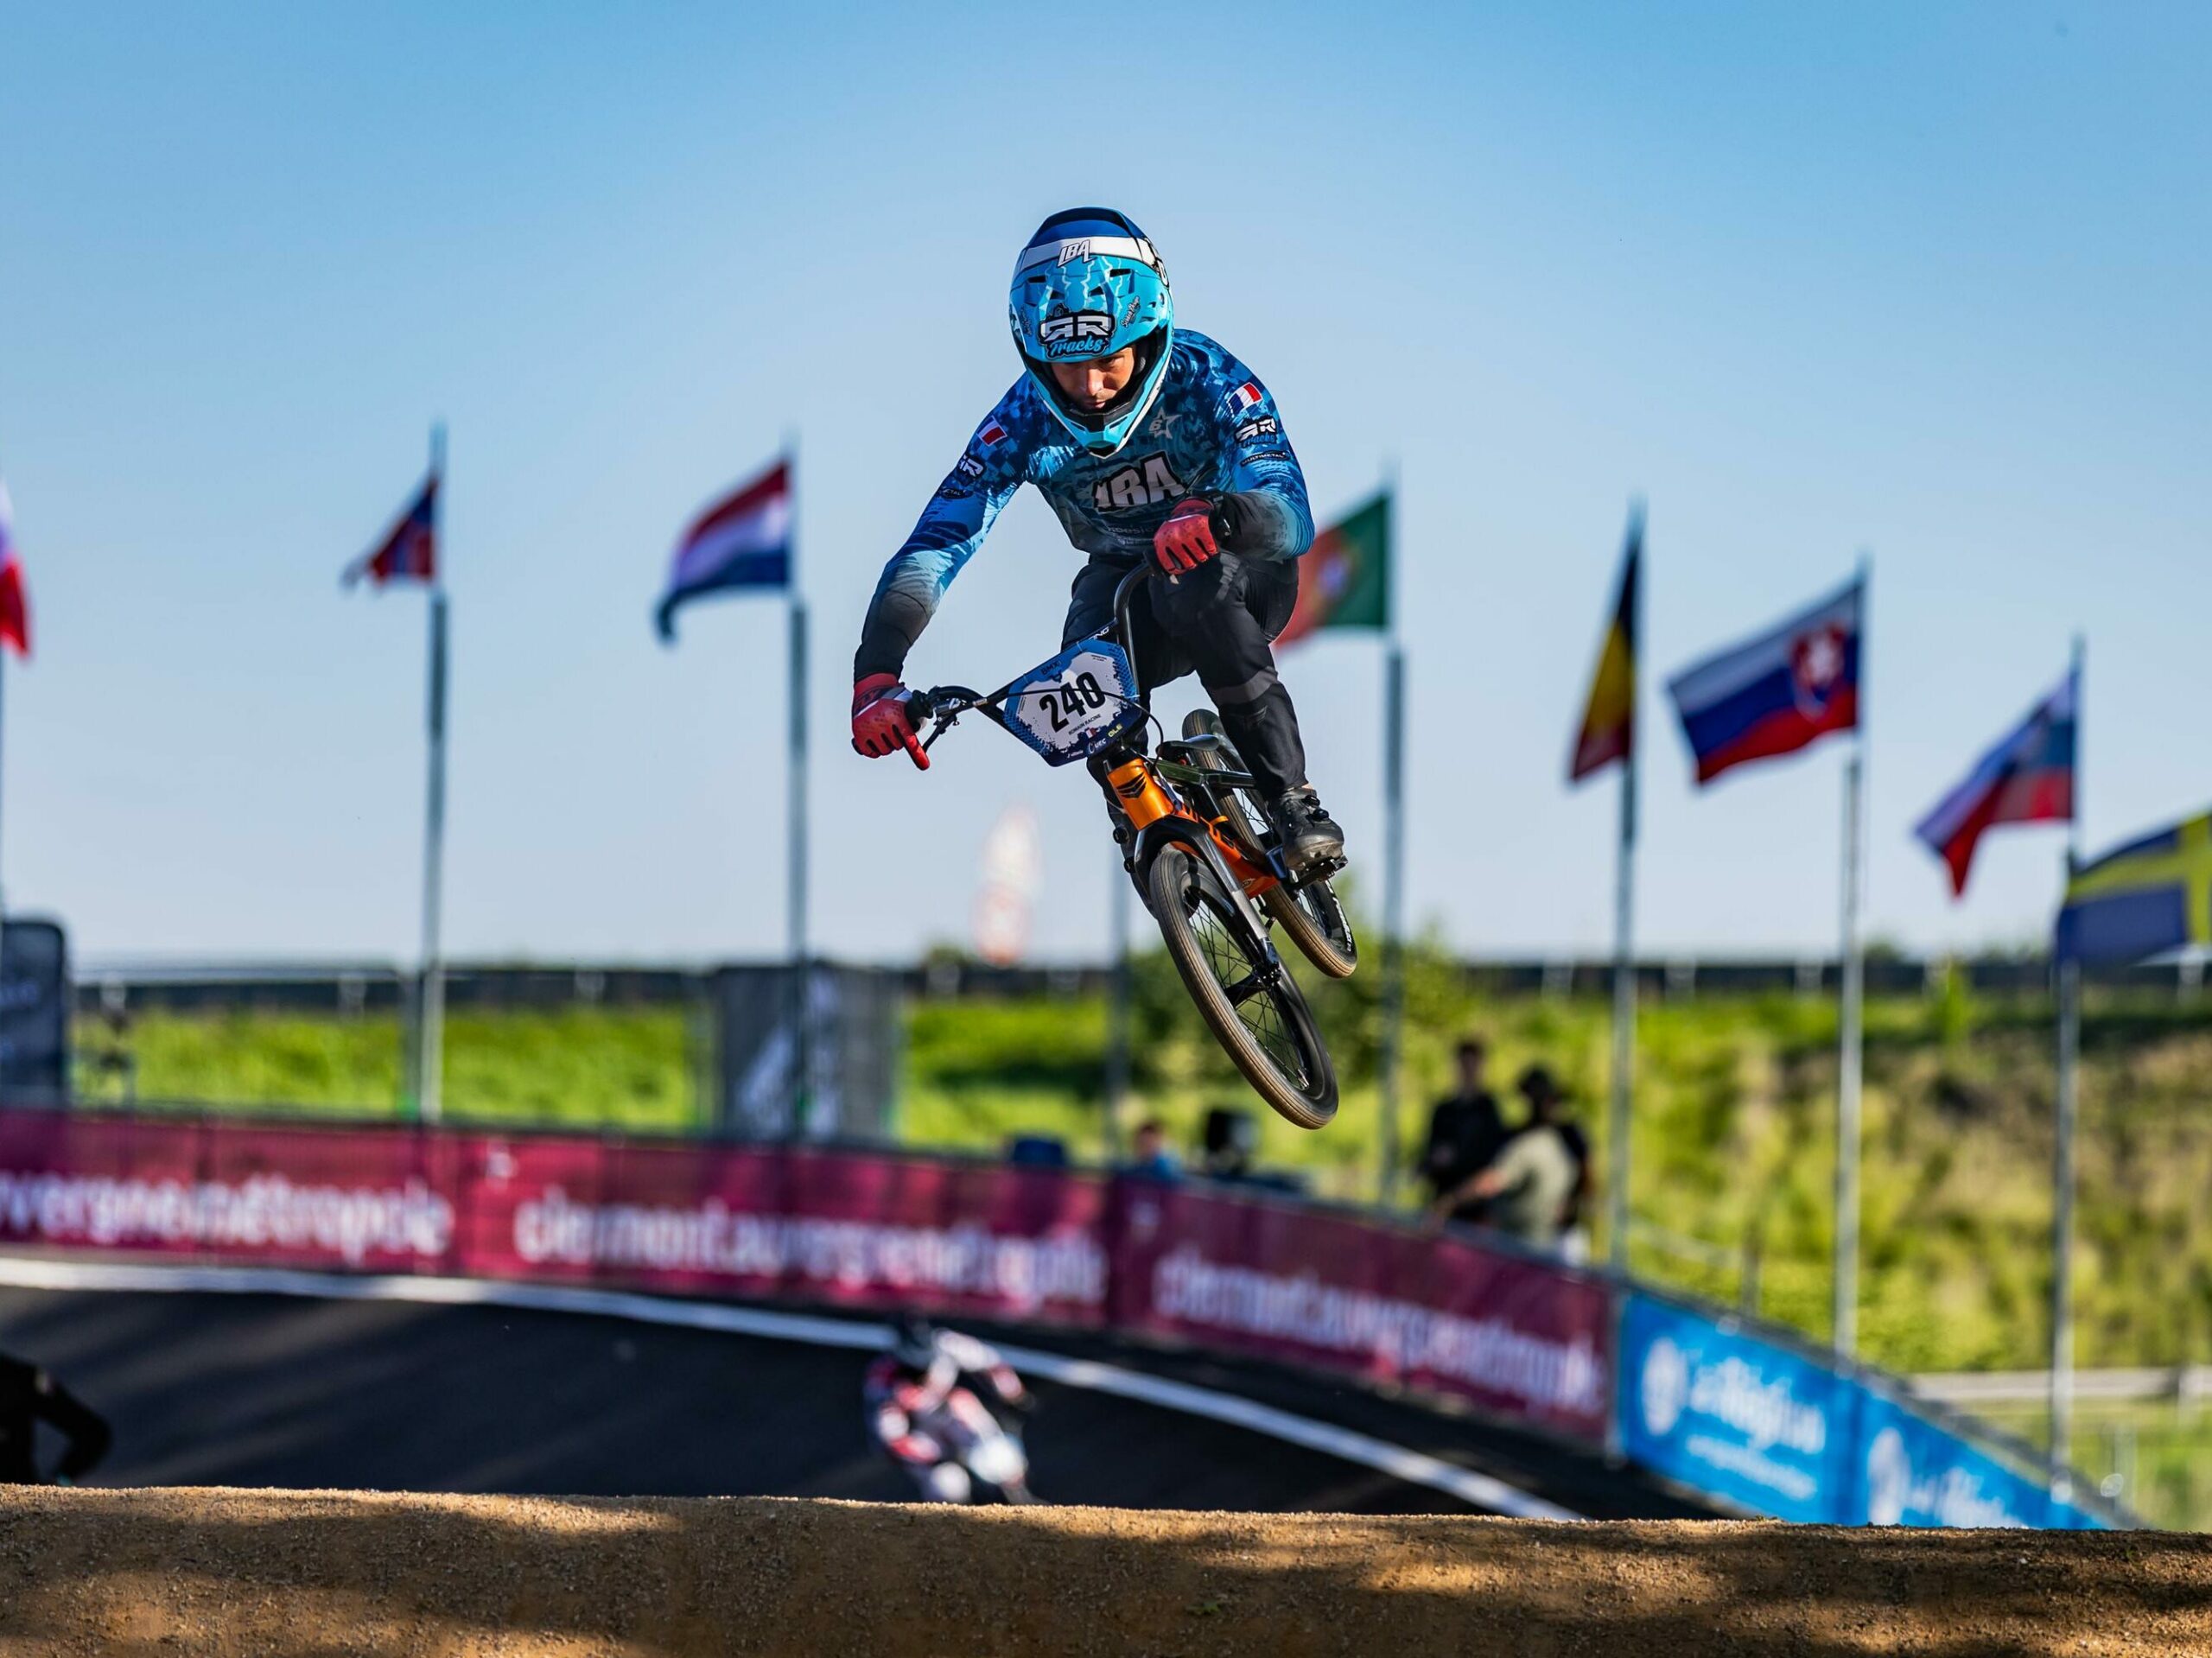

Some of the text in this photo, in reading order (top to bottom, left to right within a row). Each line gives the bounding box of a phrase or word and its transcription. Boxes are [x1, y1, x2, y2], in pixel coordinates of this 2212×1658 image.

[1058, 239, 1092, 267] IBA
[1049, 338, 1103, 353] Tracks
[1039, 672, 1106, 733] 240
[1095, 738, 1106, 747] UEC
